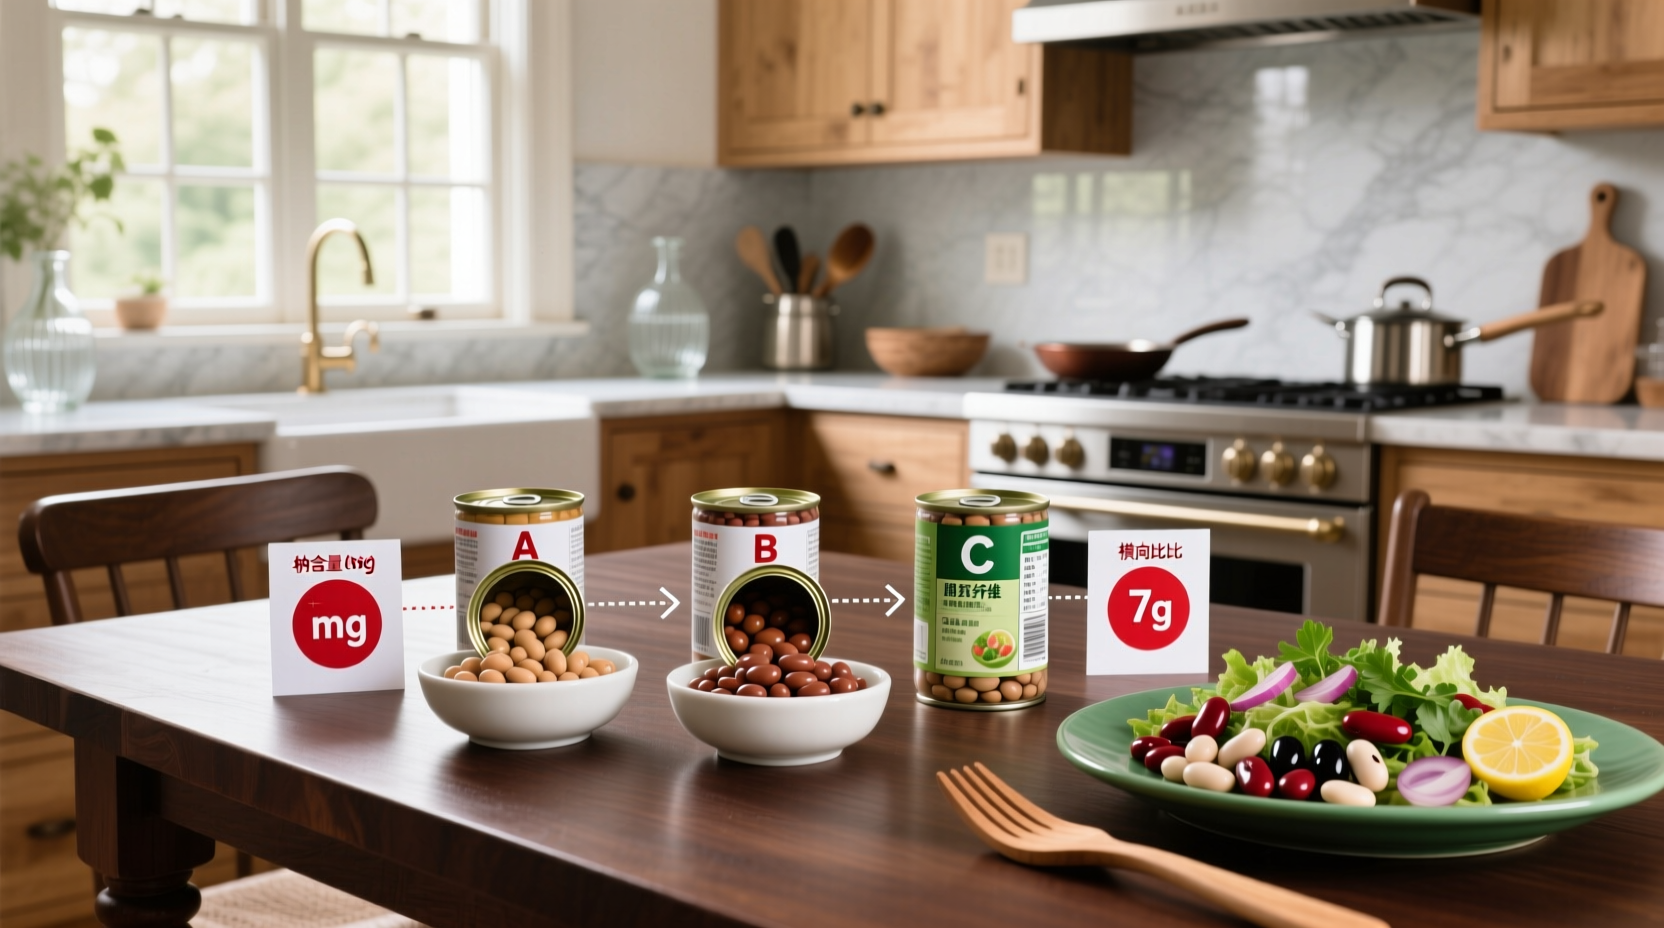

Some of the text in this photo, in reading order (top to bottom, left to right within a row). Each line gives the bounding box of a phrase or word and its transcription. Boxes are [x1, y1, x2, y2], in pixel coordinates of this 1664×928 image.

[512, 530, 539, 560] A
[754, 533, 778, 563] B
[960, 534, 995, 575] C
[1128, 588, 1172, 632] 7g
[312, 613, 367, 648] mg
